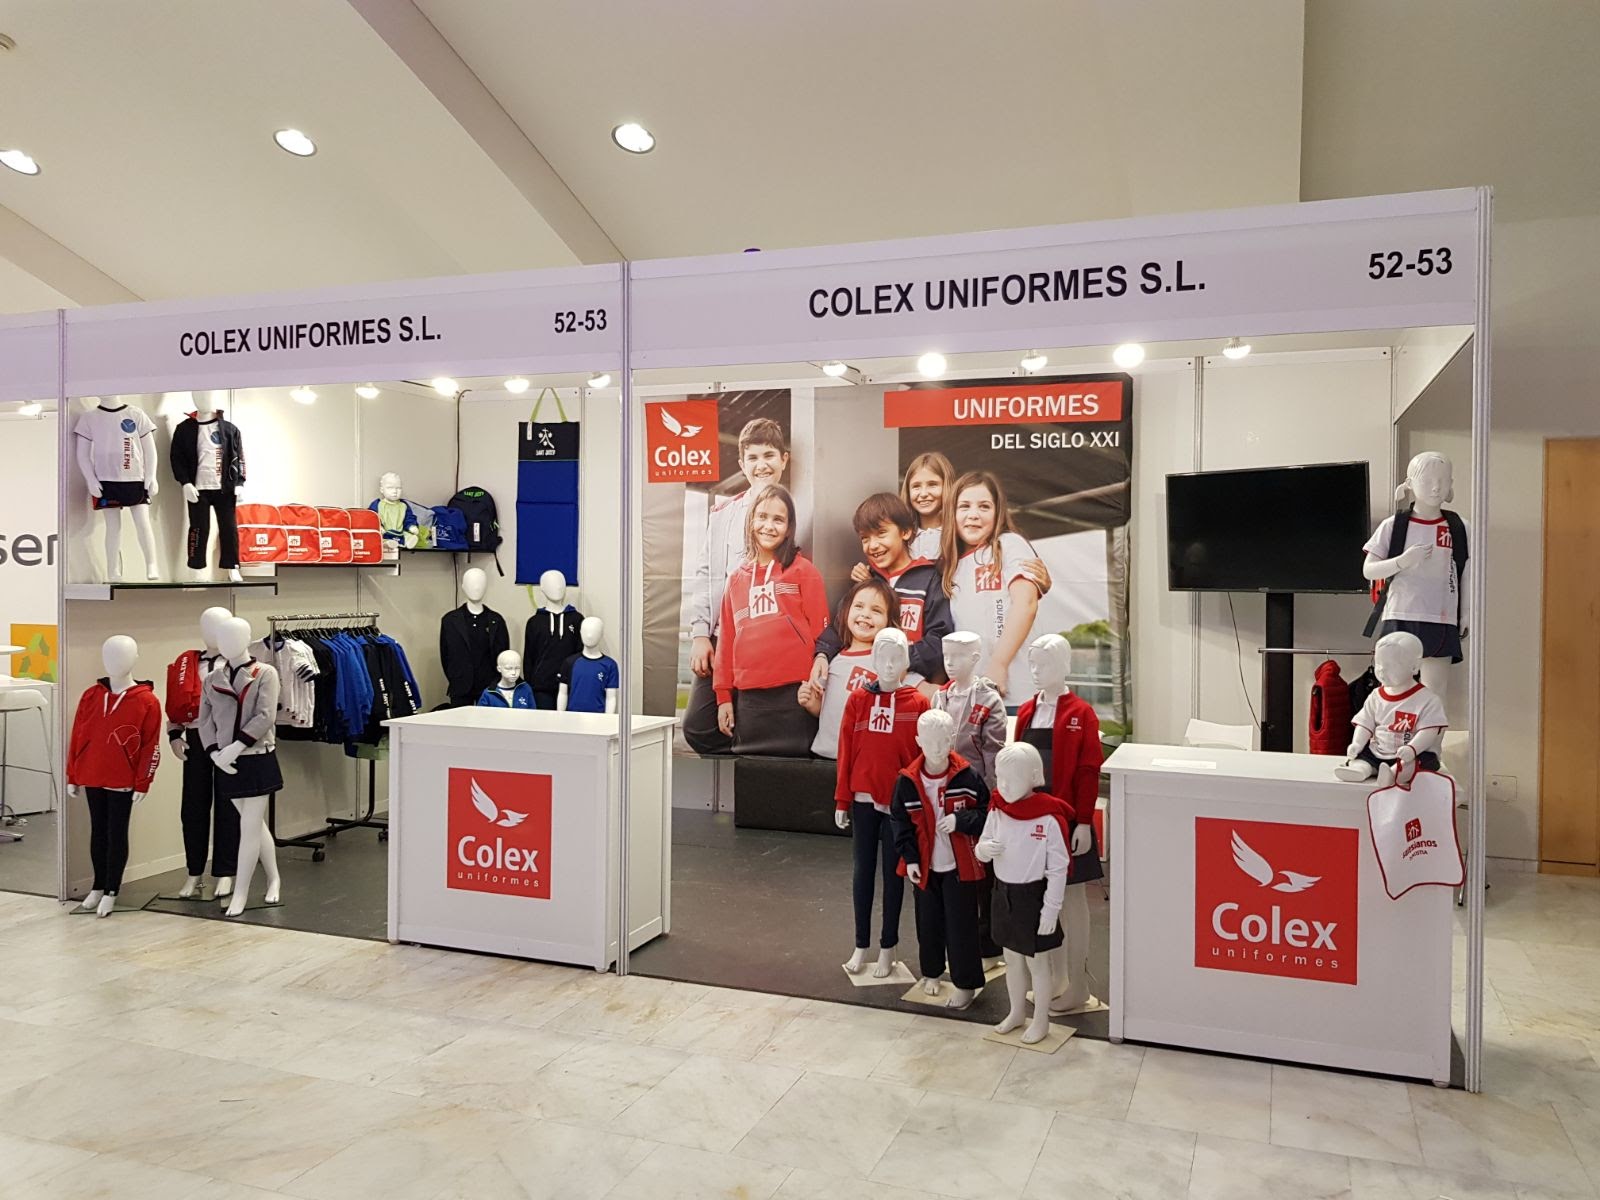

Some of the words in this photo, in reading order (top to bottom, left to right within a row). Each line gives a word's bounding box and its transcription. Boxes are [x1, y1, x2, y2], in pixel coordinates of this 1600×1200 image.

[1368, 247, 1452, 279] 52-53
[809, 282, 914, 318] COLEX
[925, 265, 1127, 311] UNIFORMES
[1140, 260, 1205, 294] S.L.
[554, 308, 607, 333] 52-53
[180, 328, 251, 356] COLEX
[258, 318, 391, 351] UNIFORMES
[398, 315, 441, 342] S.L.
[953, 394, 1099, 419] UNIFORMES
[991, 433, 1025, 449] DEL
[1030, 432, 1084, 449] SIGLO
[1089, 431, 1119, 447] XXI
[654, 444, 711, 467] Colex
[457, 835, 539, 873] Colex
[457, 872, 539, 887] uniformes
[1211, 902, 1338, 951] Colex
[1212, 947, 1338, 969] uniformes
